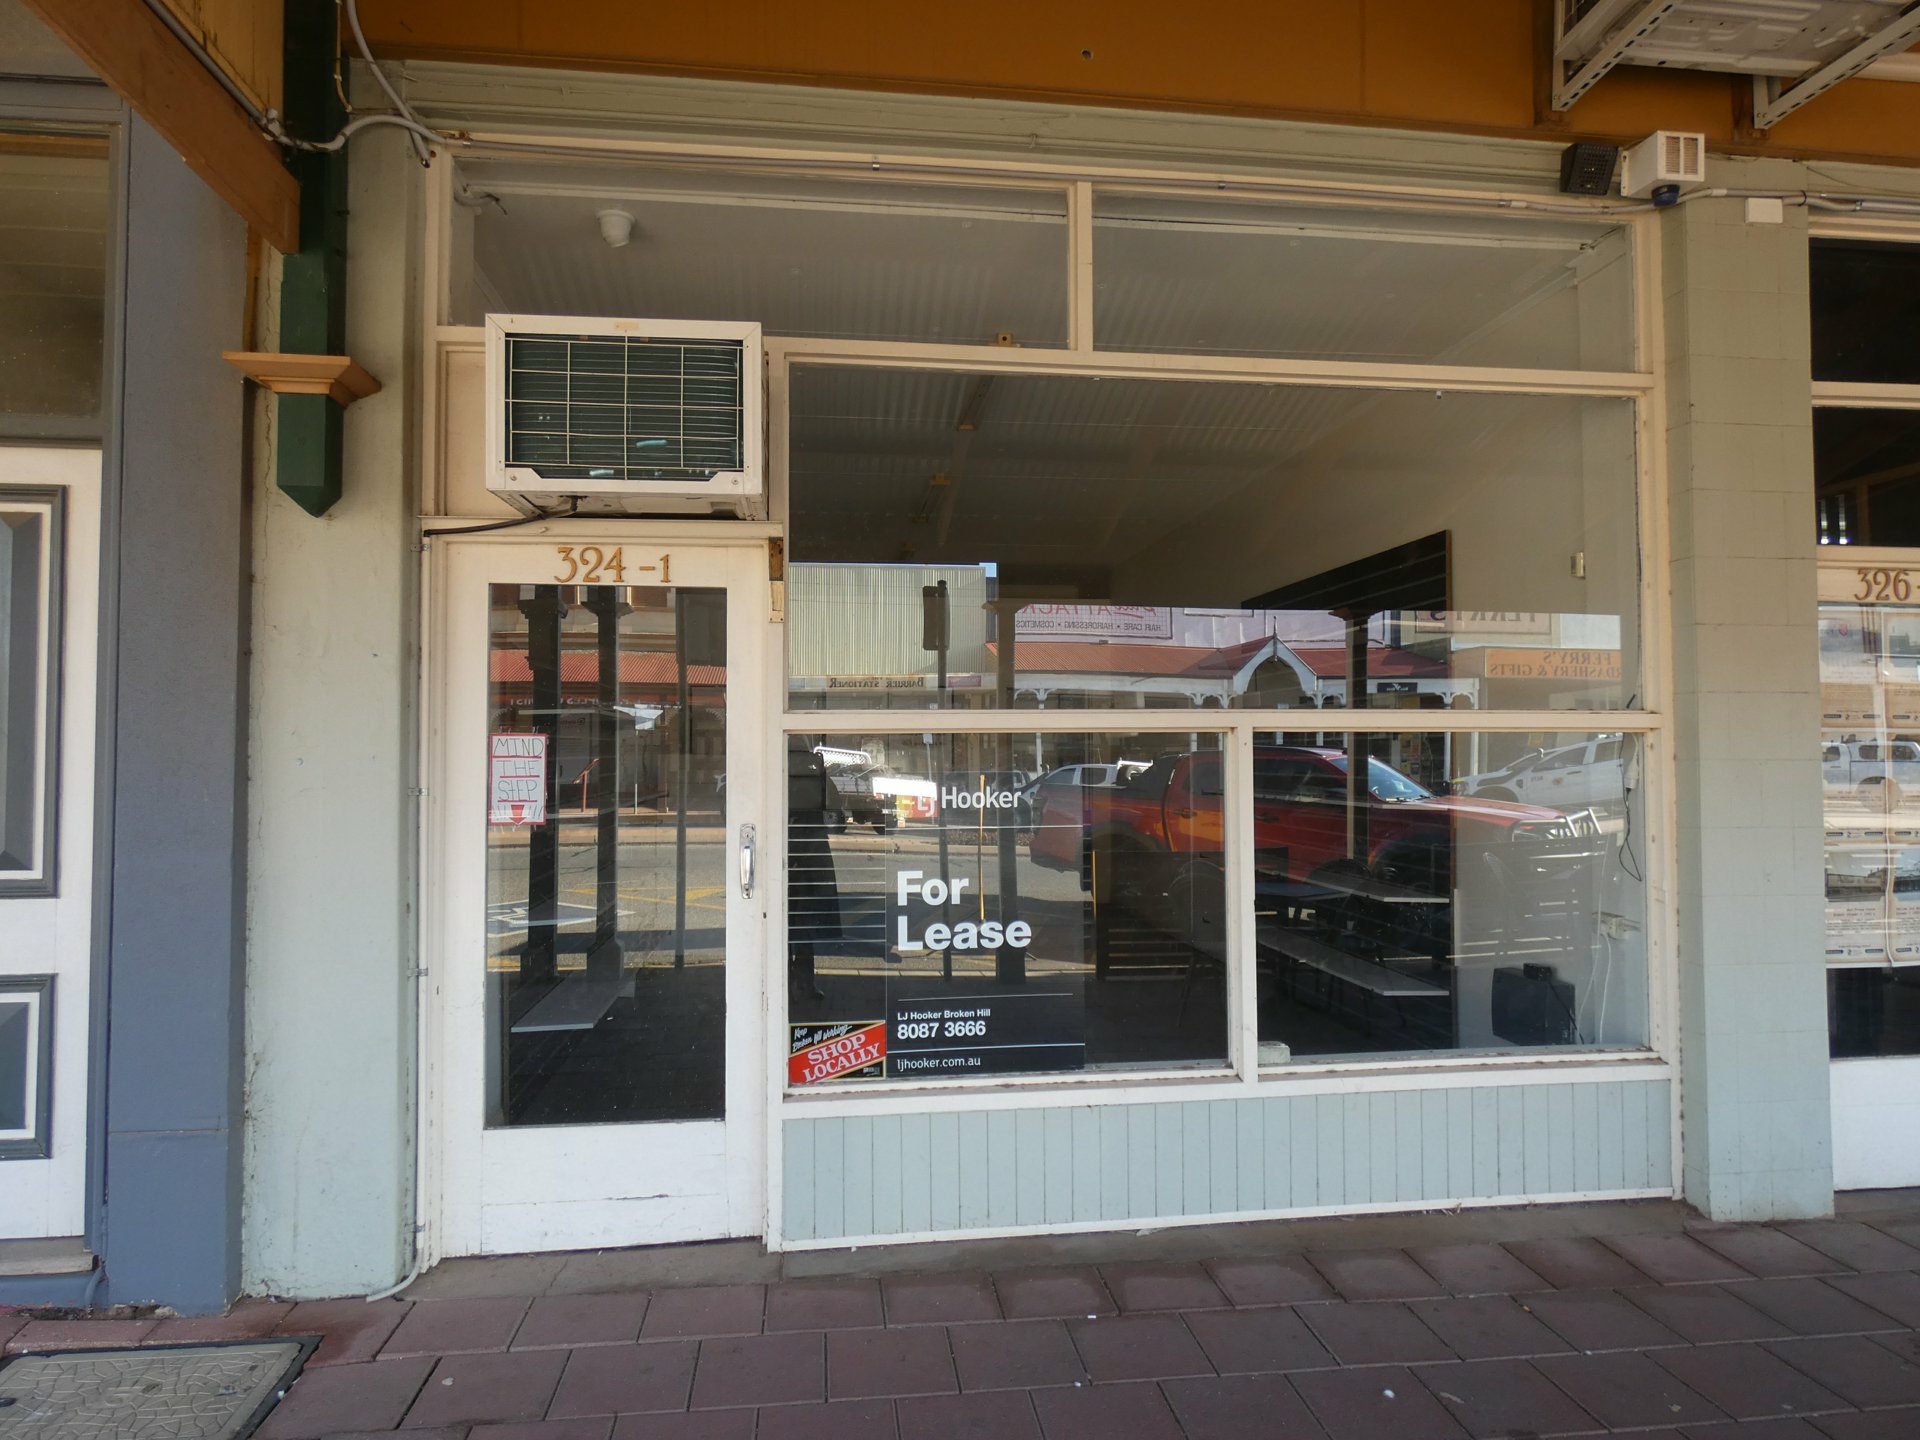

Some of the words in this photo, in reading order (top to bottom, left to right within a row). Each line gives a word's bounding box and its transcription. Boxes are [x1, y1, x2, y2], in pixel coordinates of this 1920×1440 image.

[1854, 568, 1920, 601] 326
[494, 738, 544, 756] MIND
[496, 760, 540, 776] THE
[941, 786, 1021, 809] Hooker
[897, 870, 969, 906] For
[897, 915, 1032, 951] Lease
[897, 1012, 908, 1020] LJ
[910, 1011, 942, 1020] Hooker
[944, 1010, 975, 1019] Broken
[977, 1008, 991, 1017] Hill
[897, 1022, 940, 1039] 8087
[944, 1020, 986, 1038] 3666
[807, 1033, 866, 1065] SHOP
[803, 1042, 880, 1082] LOCALLY
[897, 1057, 981, 1072] ljhooker.com.au
